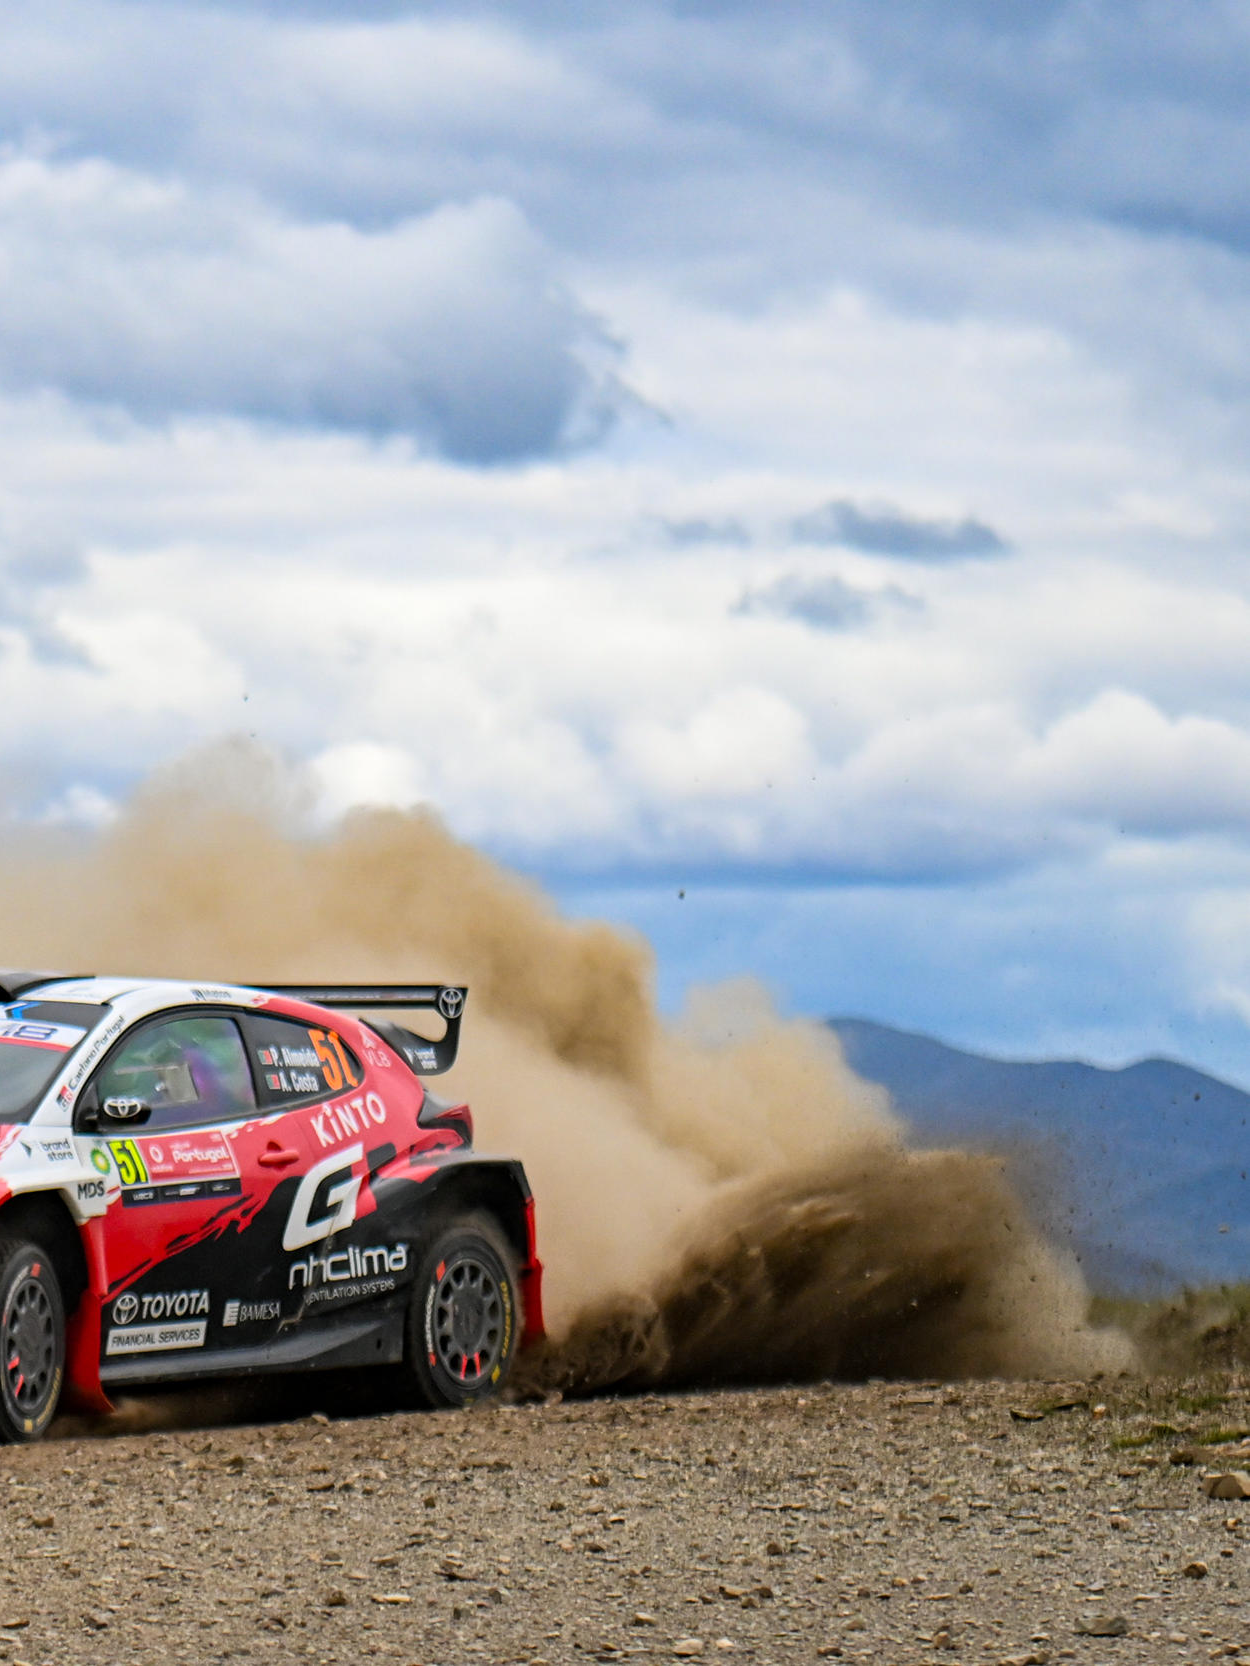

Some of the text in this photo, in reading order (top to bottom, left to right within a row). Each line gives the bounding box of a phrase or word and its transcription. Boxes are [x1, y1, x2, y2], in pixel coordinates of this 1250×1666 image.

[270, 1045, 283, 1067] P.
[307, 1029, 359, 1091] 51
[279, 1073, 319, 1092] A. Costa
[109, 1139, 150, 1185] 51
[172, 1145, 230, 1164] Portugal
[77, 1181, 105, 1200] MDS
[361, 1278, 395, 1296] SYSTEMS
[141, 1290, 210, 1319] TOYOTA
[239, 1302, 282, 1322] BAMESA
[111, 1327, 201, 1348] FINANCIAL SERVICES
